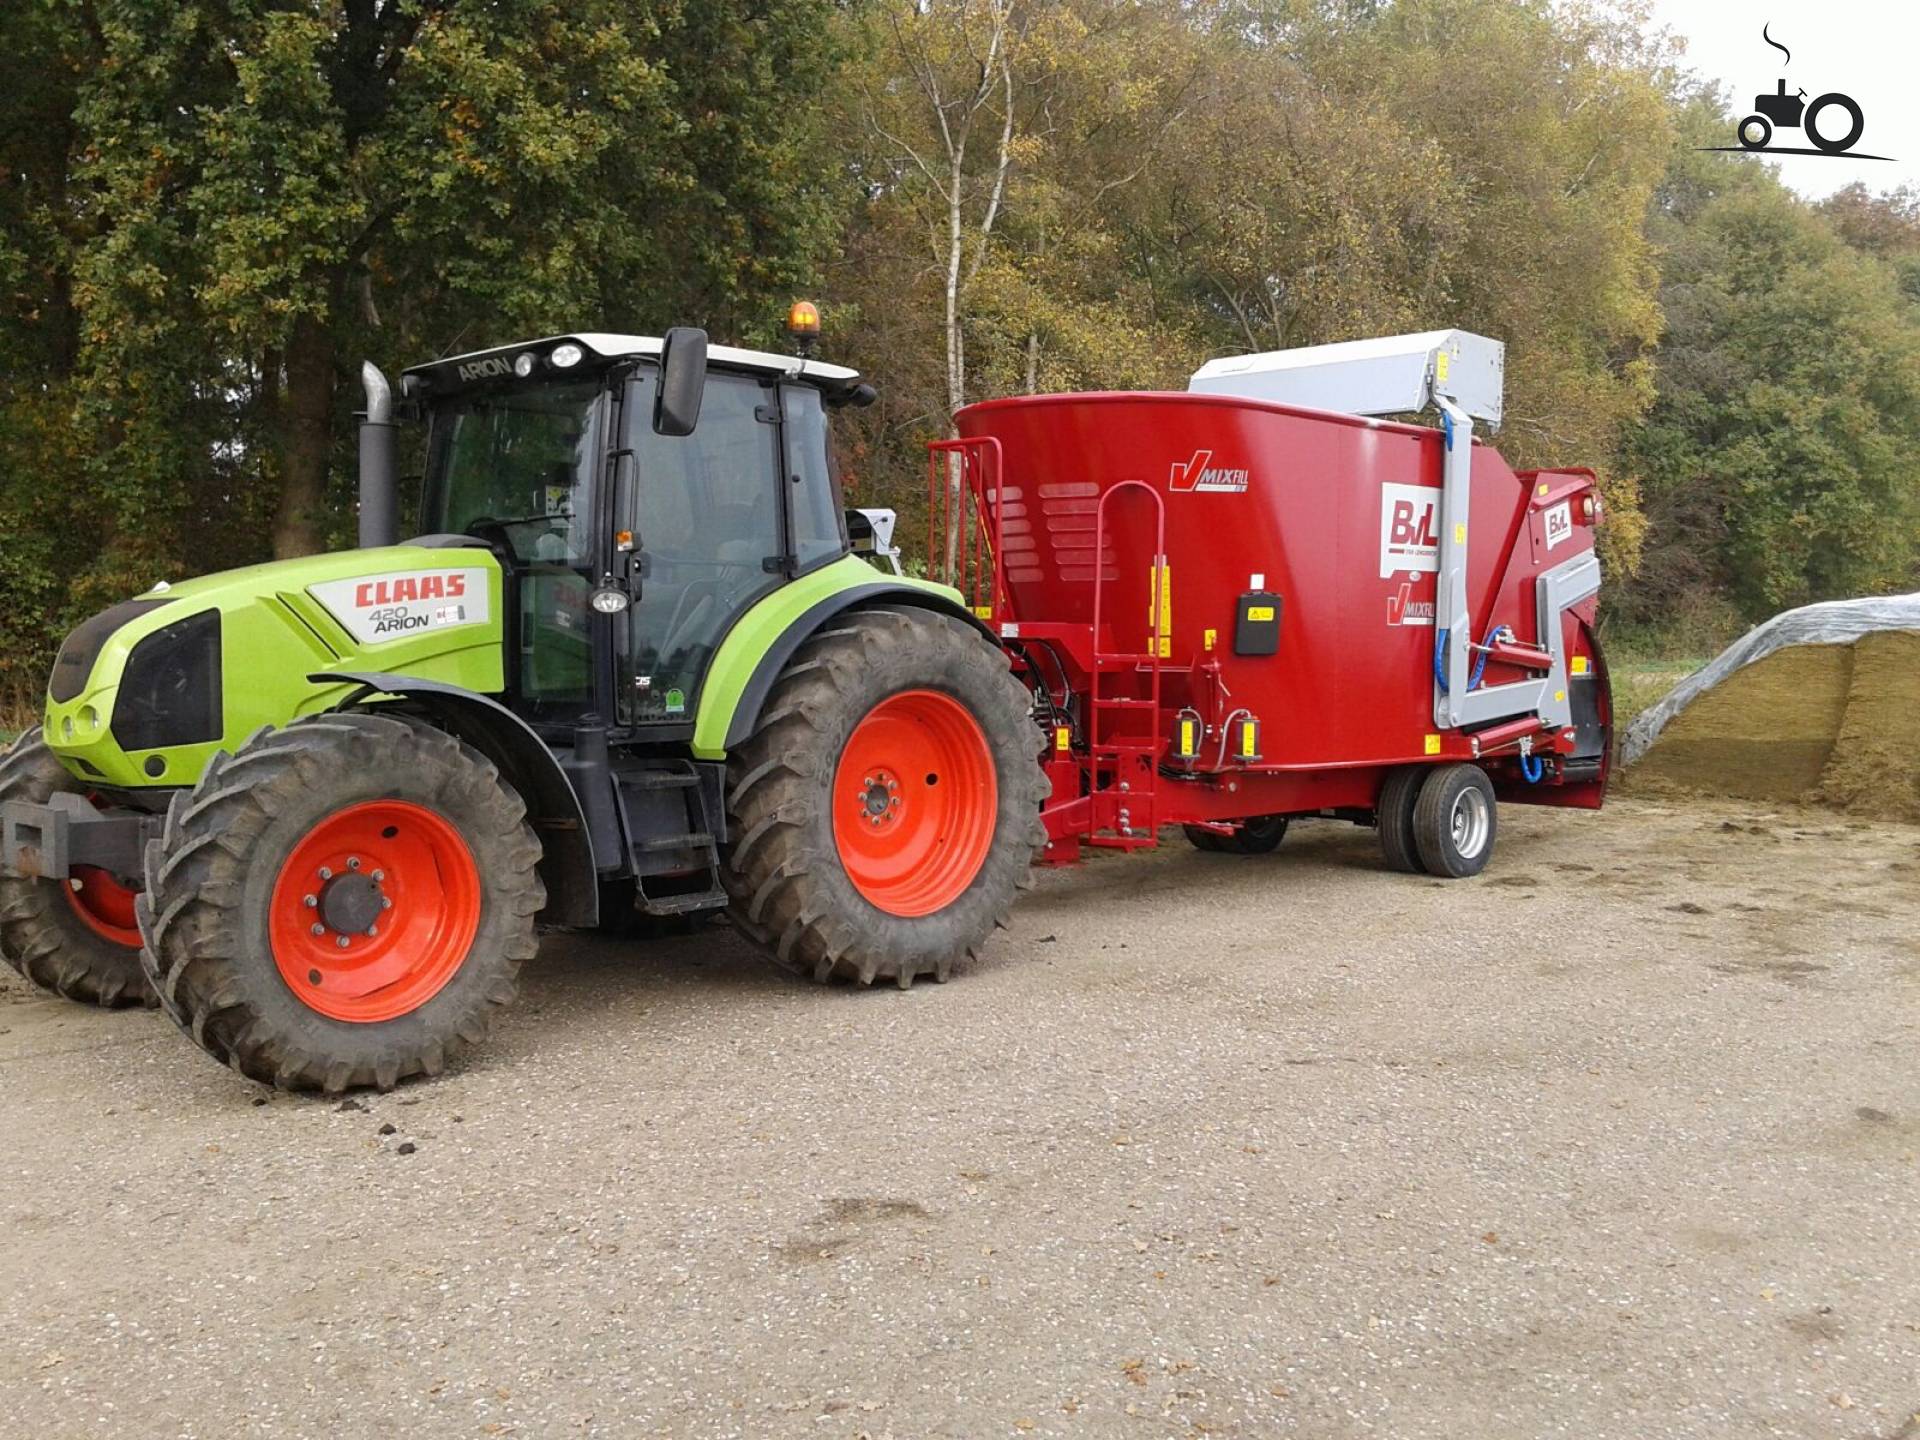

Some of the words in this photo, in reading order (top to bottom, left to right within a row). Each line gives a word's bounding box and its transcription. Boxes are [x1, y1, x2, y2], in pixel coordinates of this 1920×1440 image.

[457, 356, 513, 382] ARION
[355, 574, 466, 608] CLAAS
[368, 606, 409, 622] 420
[374, 614, 430, 635] ARION
